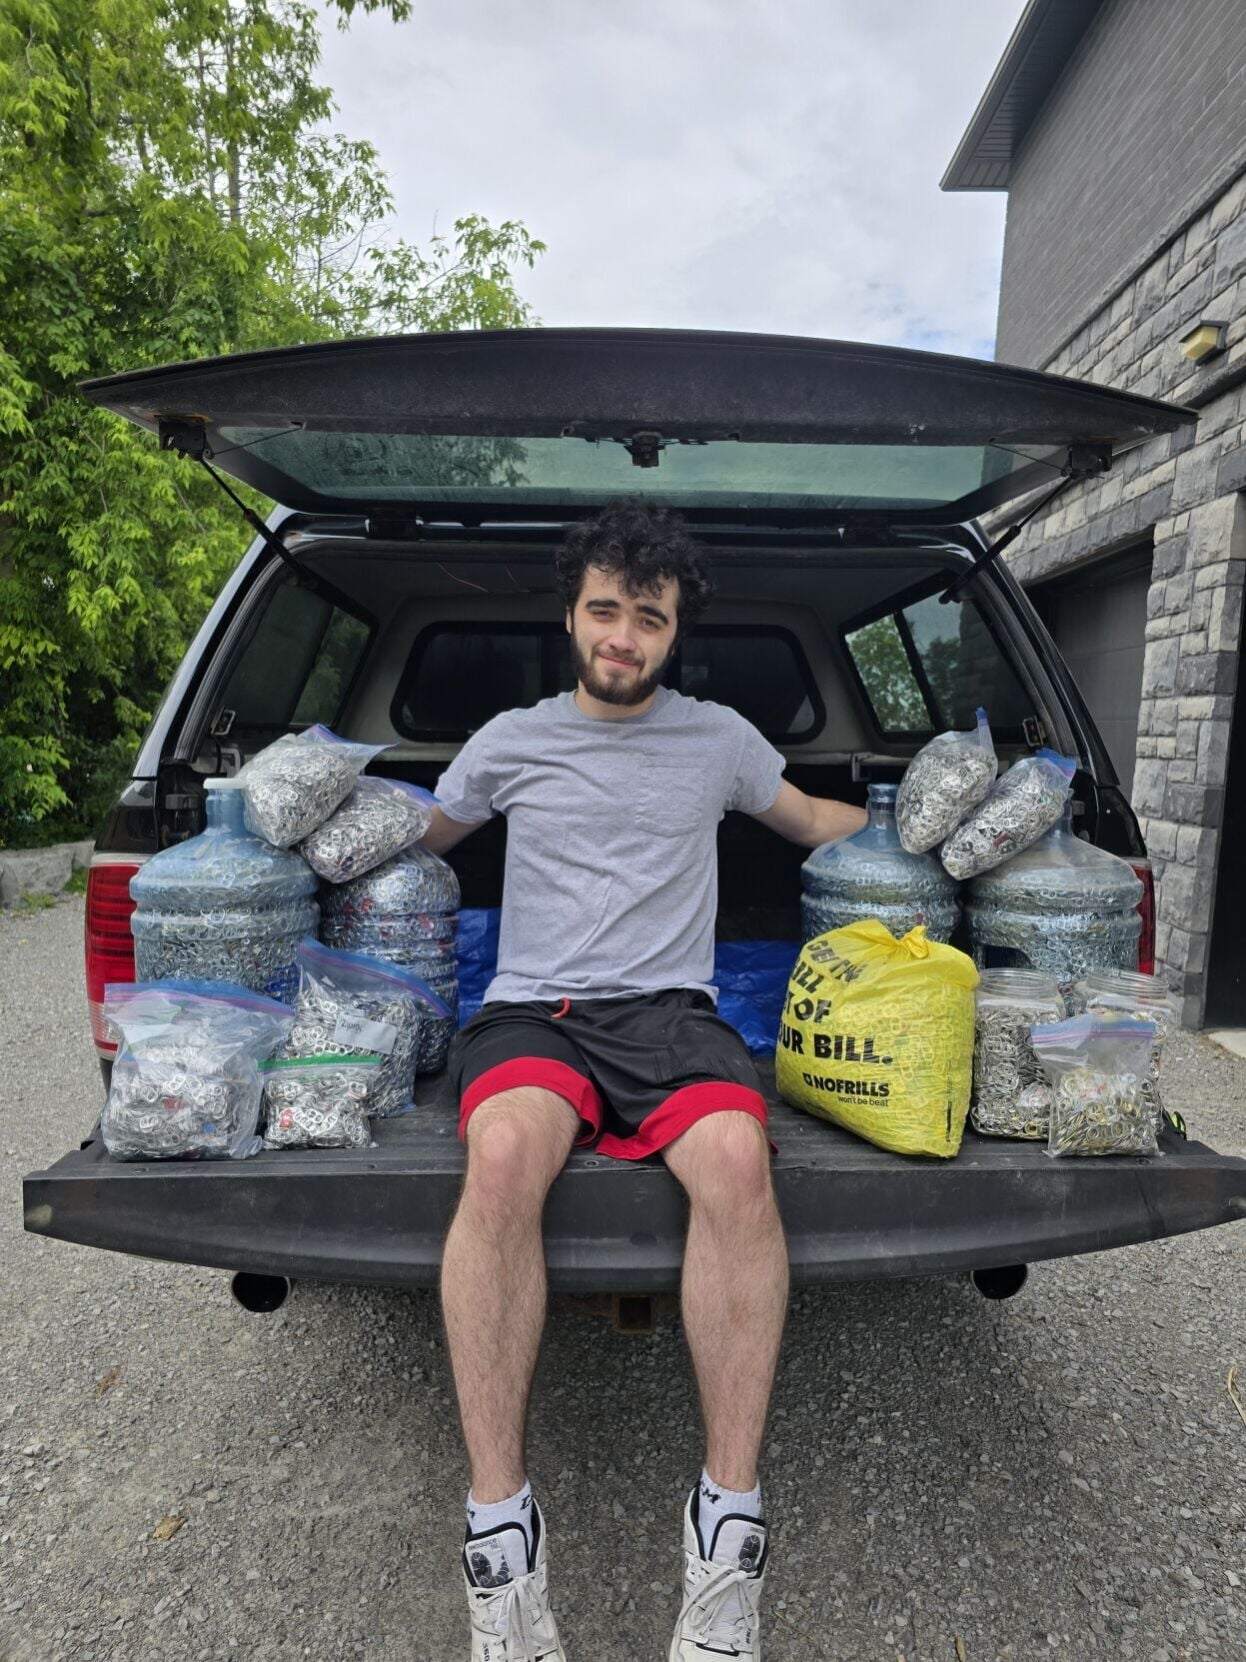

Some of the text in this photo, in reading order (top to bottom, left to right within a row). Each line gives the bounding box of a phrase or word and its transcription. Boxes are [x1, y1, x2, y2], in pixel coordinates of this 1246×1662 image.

[794, 998, 832, 1023] OF
[780, 1023, 893, 1064] UR BILL.
